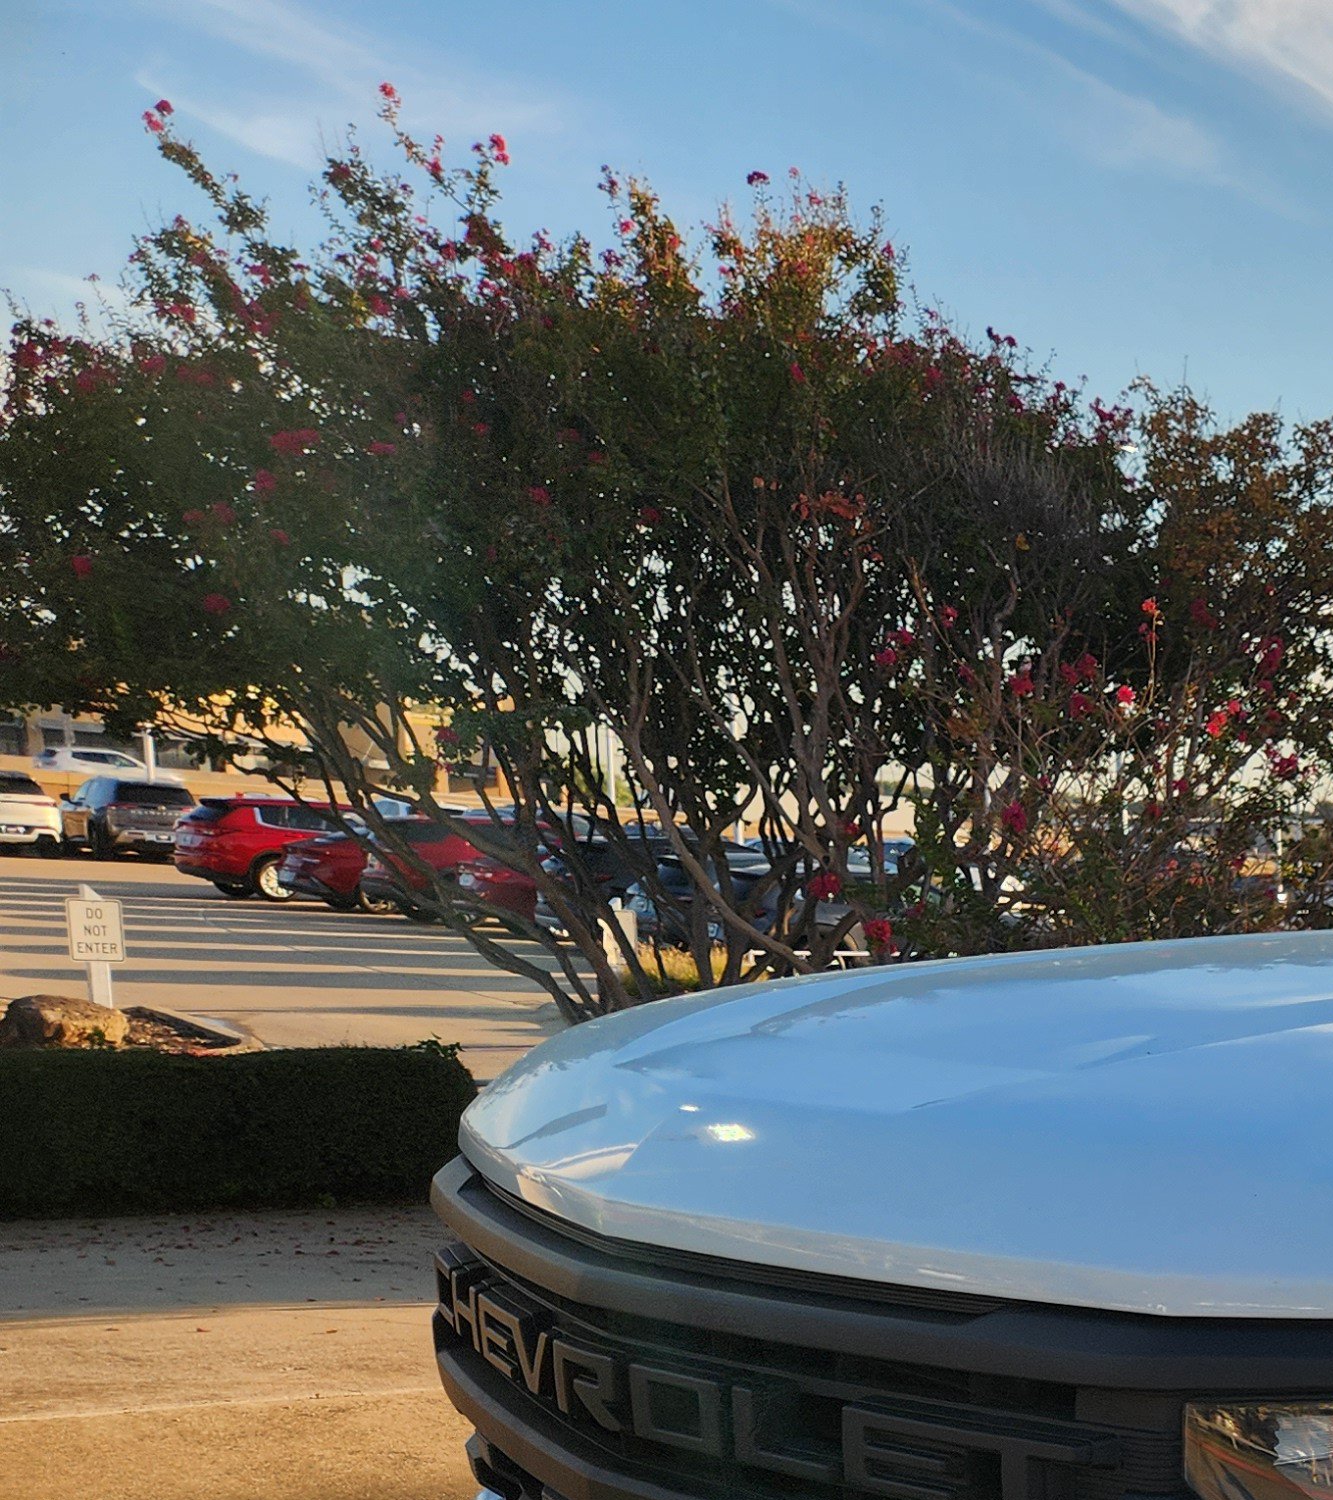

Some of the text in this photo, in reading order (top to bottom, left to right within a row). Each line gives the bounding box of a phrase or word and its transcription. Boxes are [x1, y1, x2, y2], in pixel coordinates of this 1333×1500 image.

[86, 908, 103, 919] DO
[83, 925, 107, 937] NOT
[77, 942, 118, 954] ENTER
